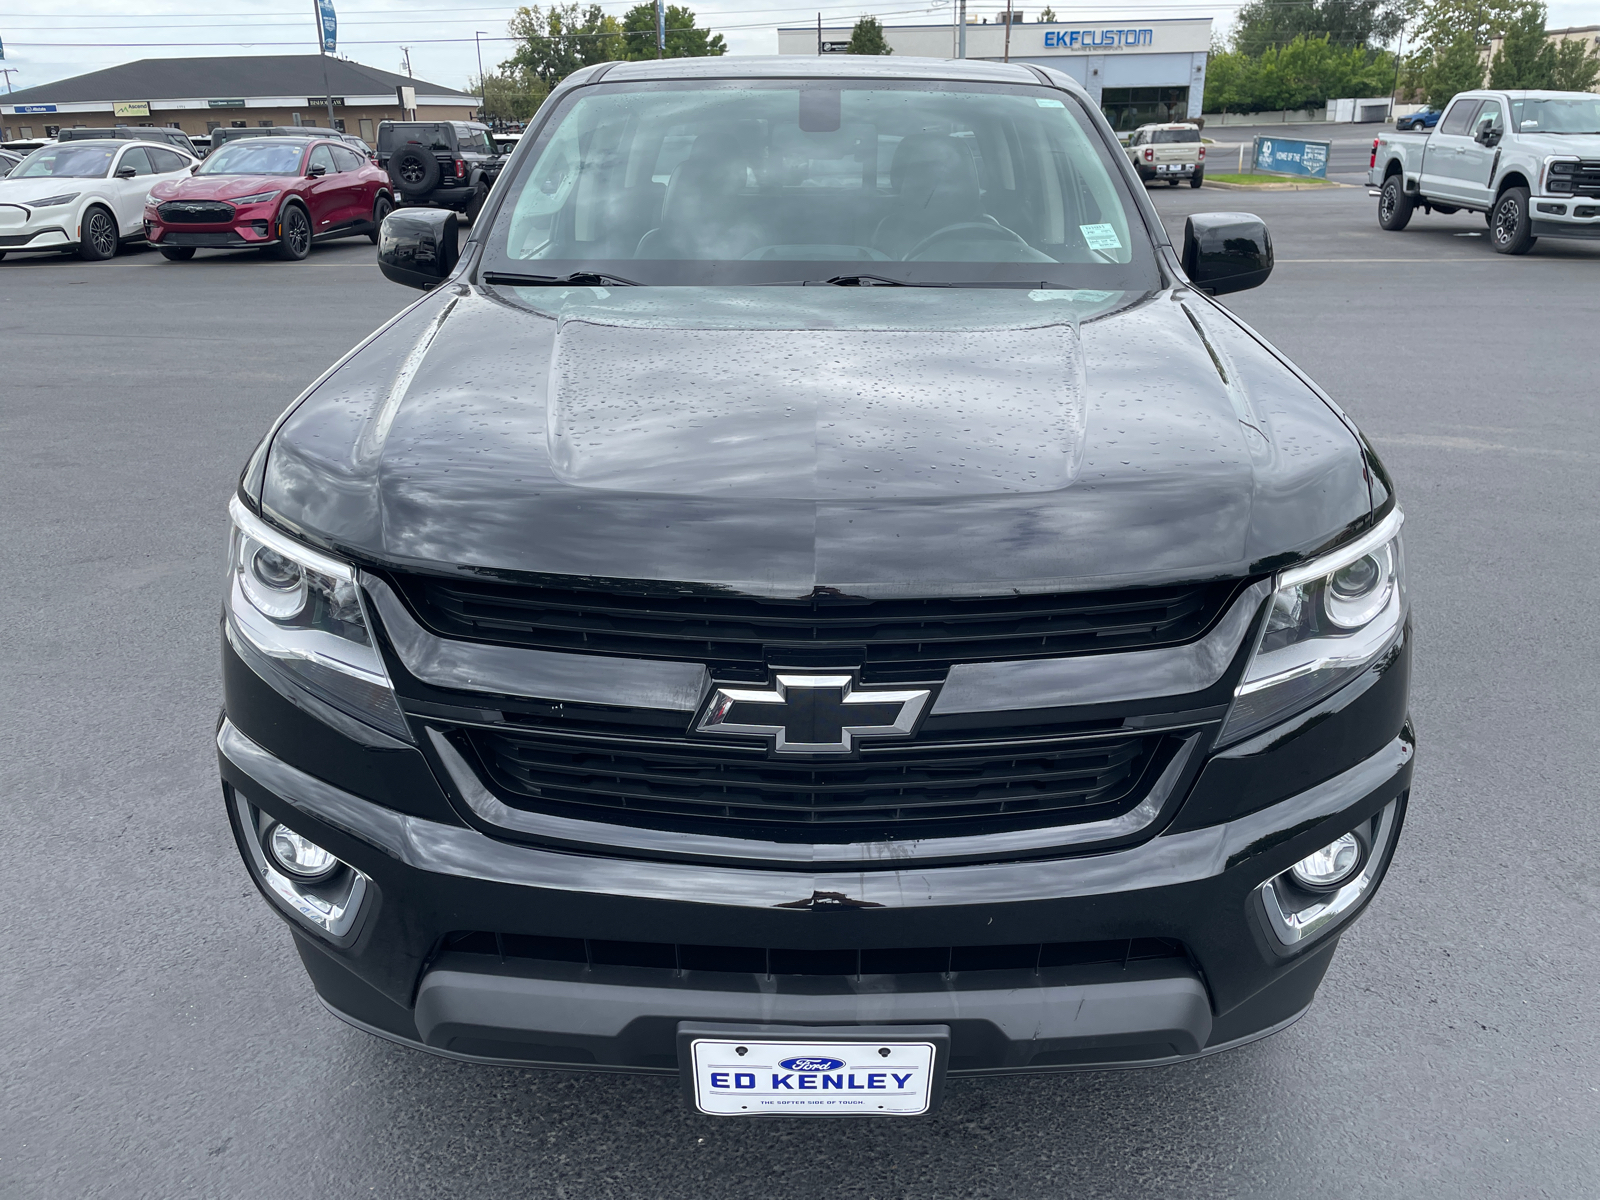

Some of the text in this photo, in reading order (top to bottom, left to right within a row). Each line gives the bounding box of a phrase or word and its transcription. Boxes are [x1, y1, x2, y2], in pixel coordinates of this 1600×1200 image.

[1044, 29, 1153, 47] EKFCUSTOM
[792, 1059, 831, 1071] Ford
[710, 1072, 913, 1090] ED KENLEY
